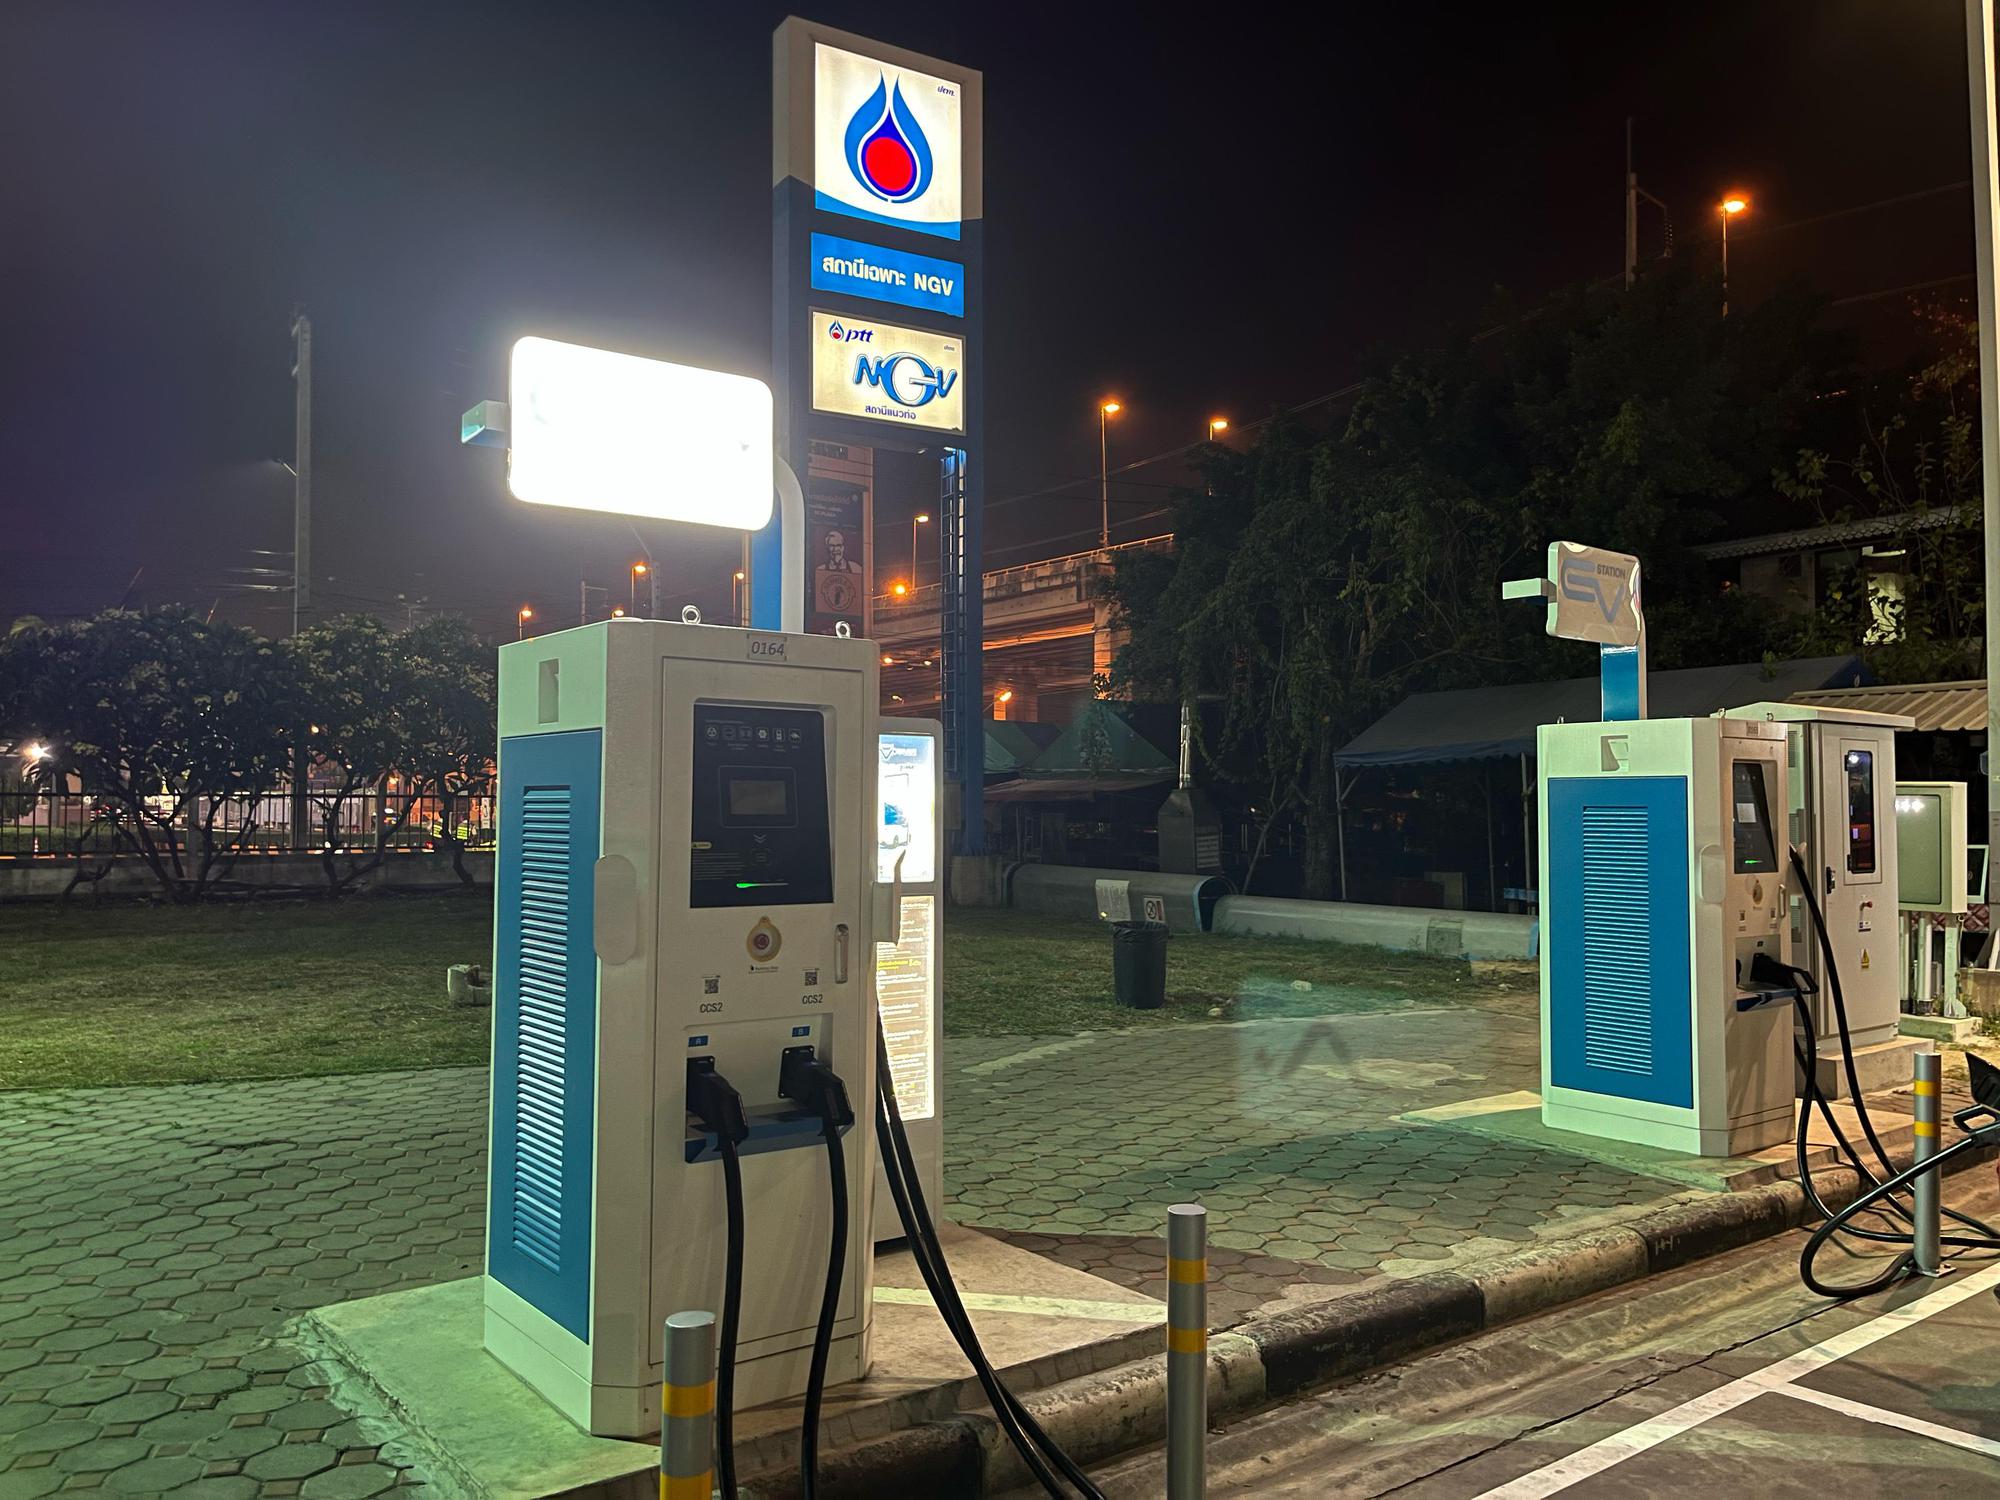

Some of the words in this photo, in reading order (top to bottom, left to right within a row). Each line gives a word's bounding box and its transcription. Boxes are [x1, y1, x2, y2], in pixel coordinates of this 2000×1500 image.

[822, 256, 907, 286] สถานีเฉพาะ
[914, 272, 954, 296] NGV
[845, 328, 874, 343] ptt
[854, 352, 958, 407] NGV
[865, 404, 917, 420] สถานีแนวท่อ
[1597, 563, 1626, 579] STATION
[1561, 558, 1625, 624] EV
[751, 641, 785, 656] 0164
[802, 994, 824, 1004] CCS2
[700, 1002, 723, 1013] CCS2
